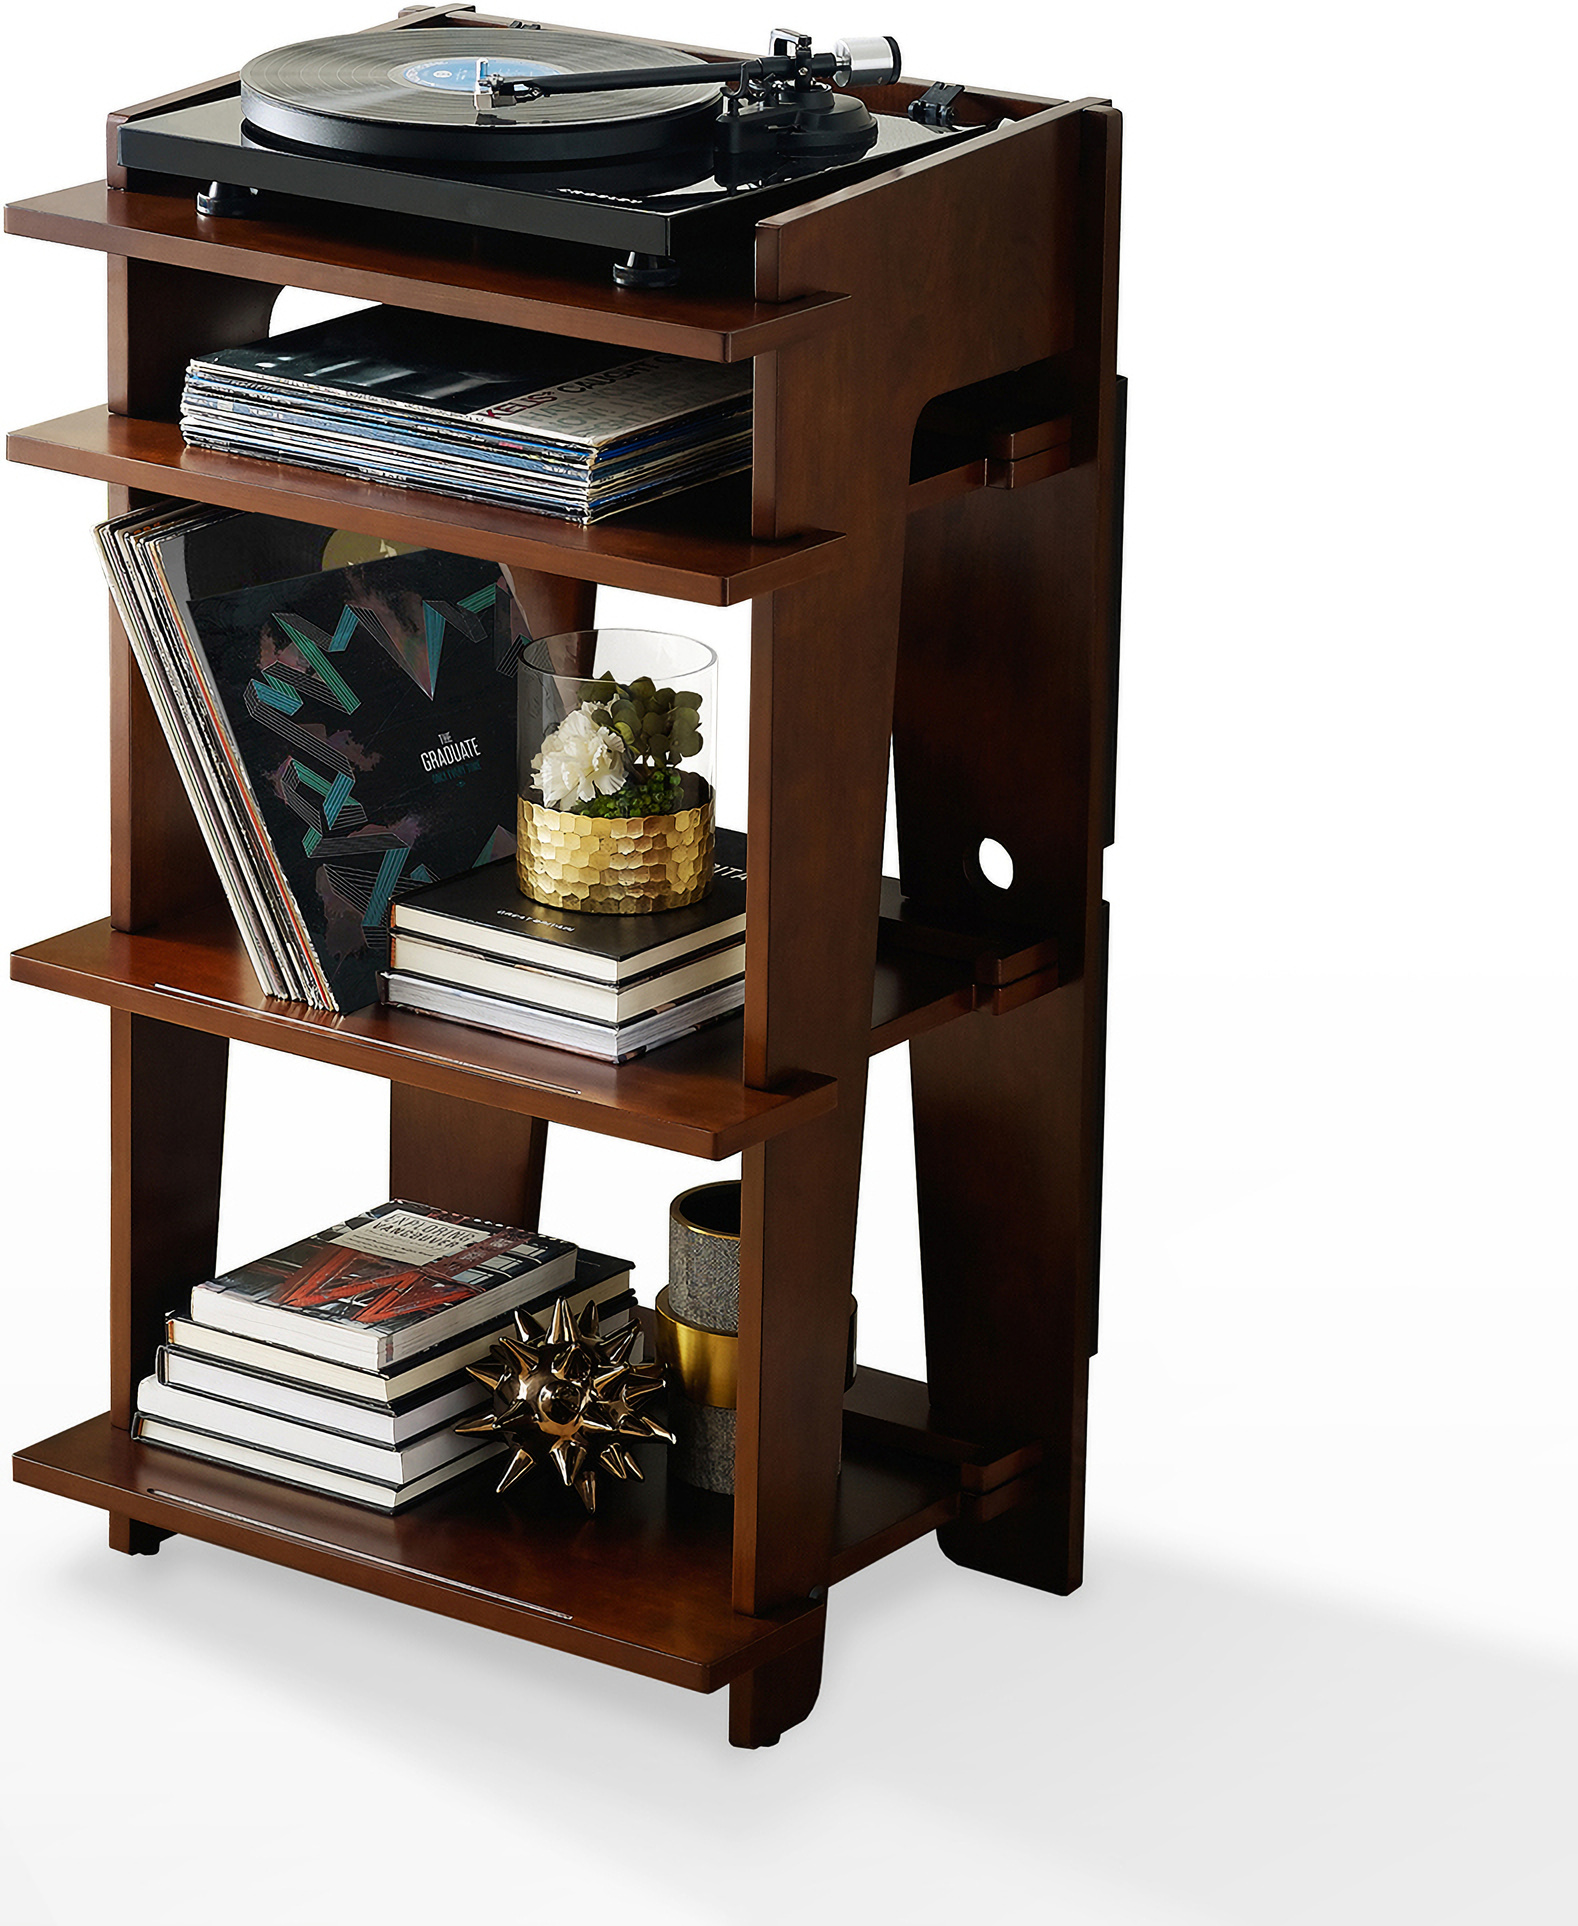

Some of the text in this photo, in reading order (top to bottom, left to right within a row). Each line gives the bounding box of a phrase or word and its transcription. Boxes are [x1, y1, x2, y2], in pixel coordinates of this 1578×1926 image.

[557, 363, 661, 393] CAUGHT
[438, 731, 453, 745] THE
[420, 736, 482, 772] GRADUATE
[372, 1221, 460, 1249] VANCOUVER
[388, 1213, 476, 1242] EXPLORING
